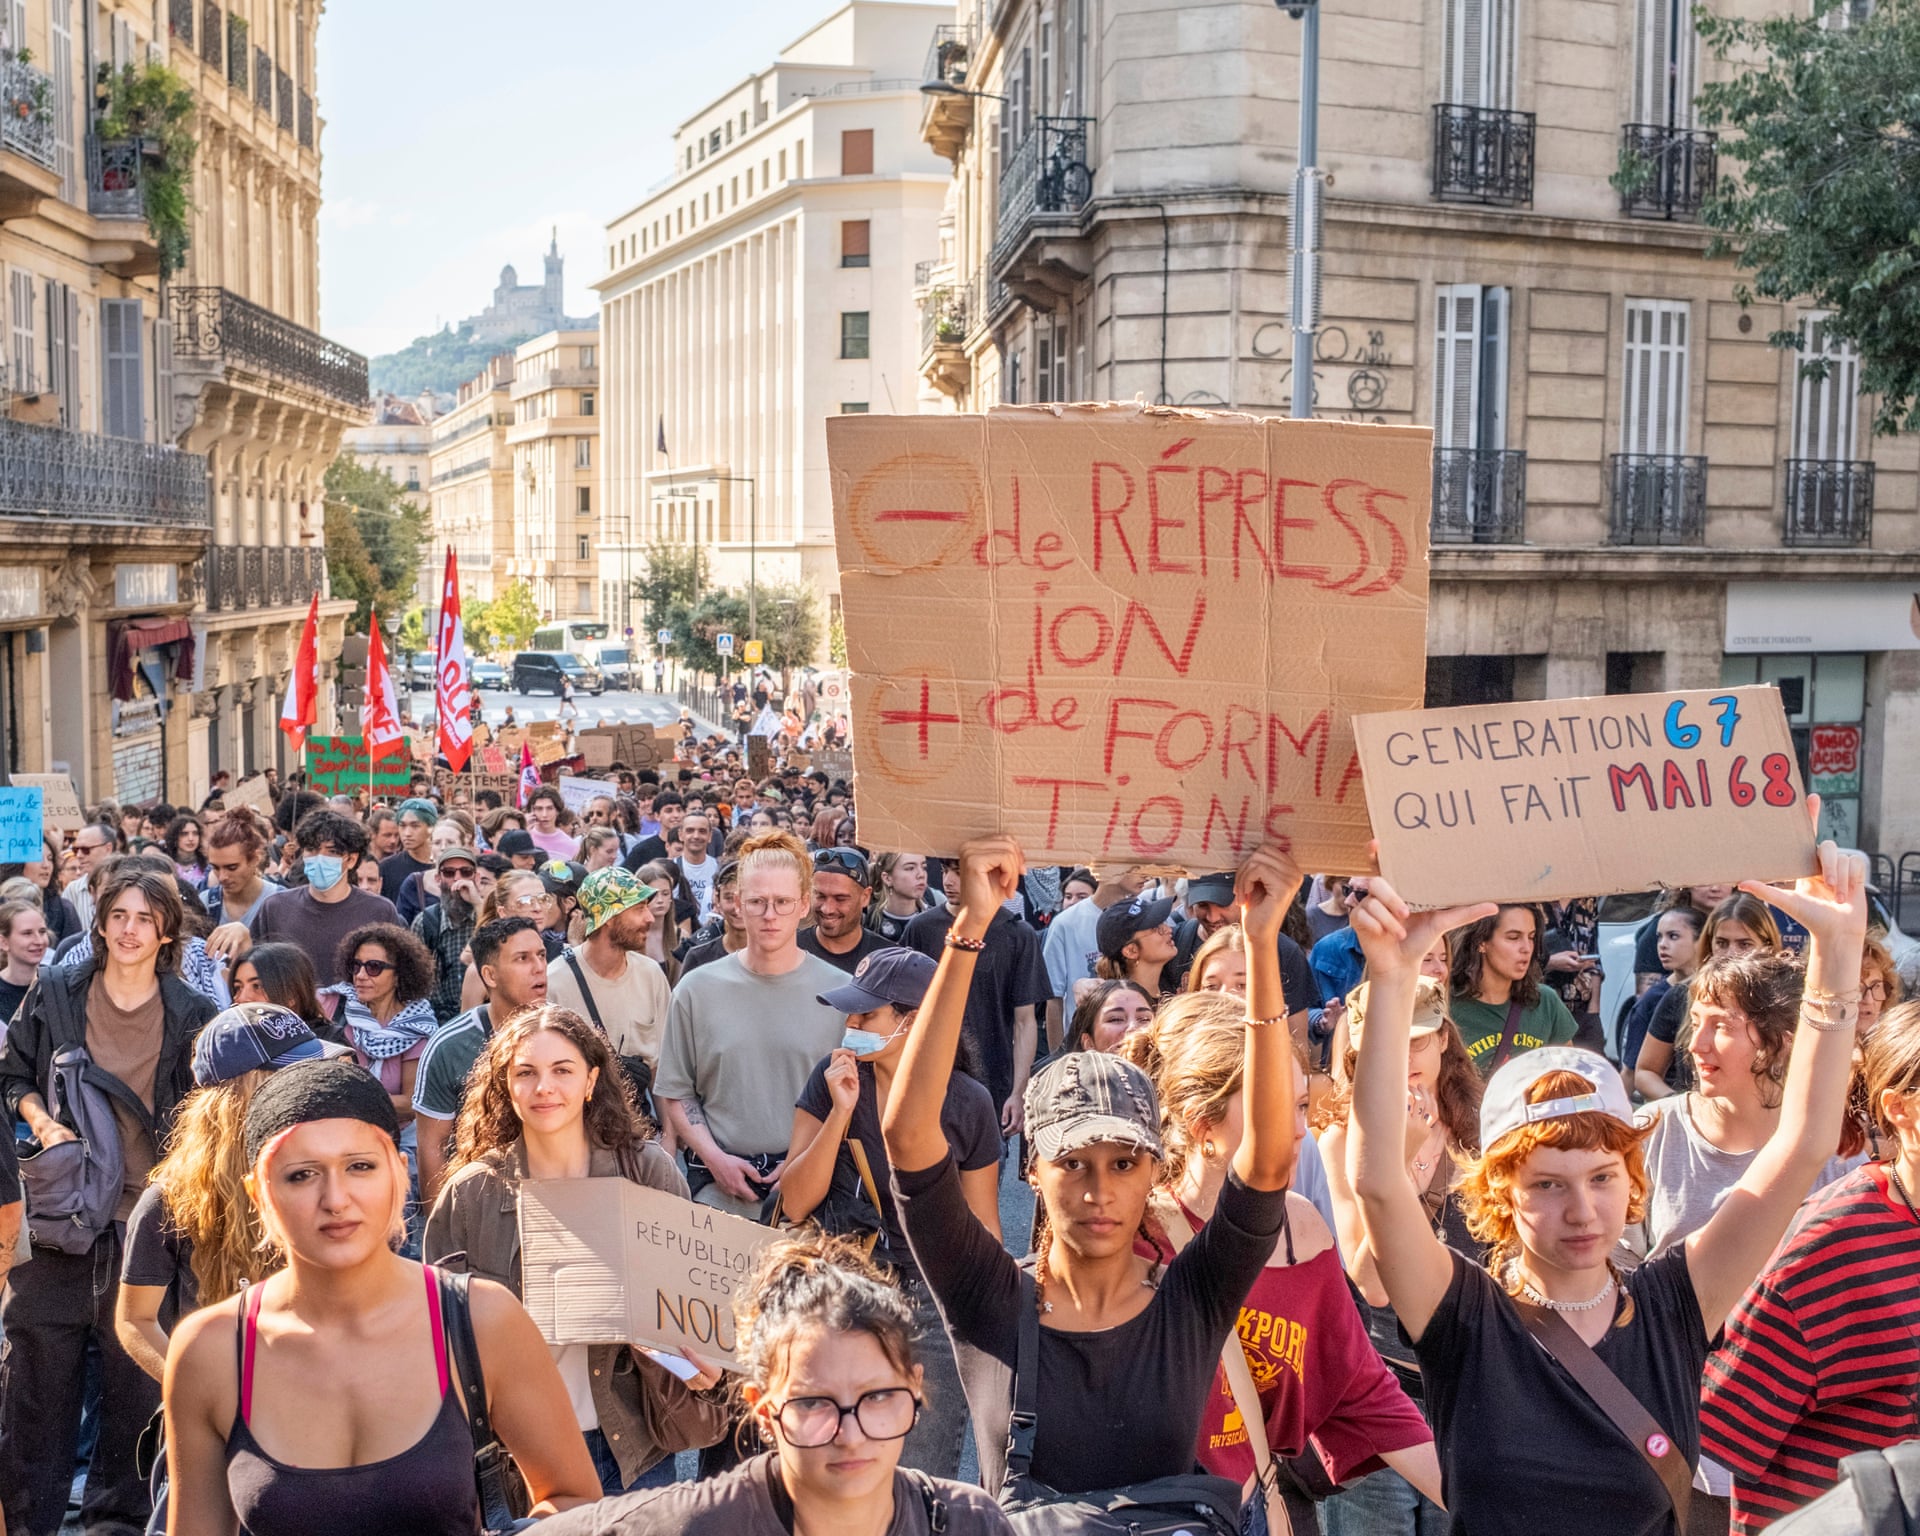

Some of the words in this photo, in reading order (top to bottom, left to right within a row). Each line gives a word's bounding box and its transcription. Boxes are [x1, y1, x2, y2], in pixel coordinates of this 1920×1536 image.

[972, 469, 1075, 571] de
[1092, 437, 1409, 597] RÉPRESS
[1733, 636, 1758, 645] CENTRE
[1761, 636, 1770, 644] DE
[1772, 635, 1812, 645] FORMATION
[977, 656, 1085, 735] de
[1386, 712, 1652, 766] GENERATION
[1664, 695, 1741, 749] 67
[1394, 788, 1476, 830] QUI
[1607, 758, 1712, 812] MAI
[1728, 752, 1797, 808] 68
[691, 1209, 714, 1233] LA
